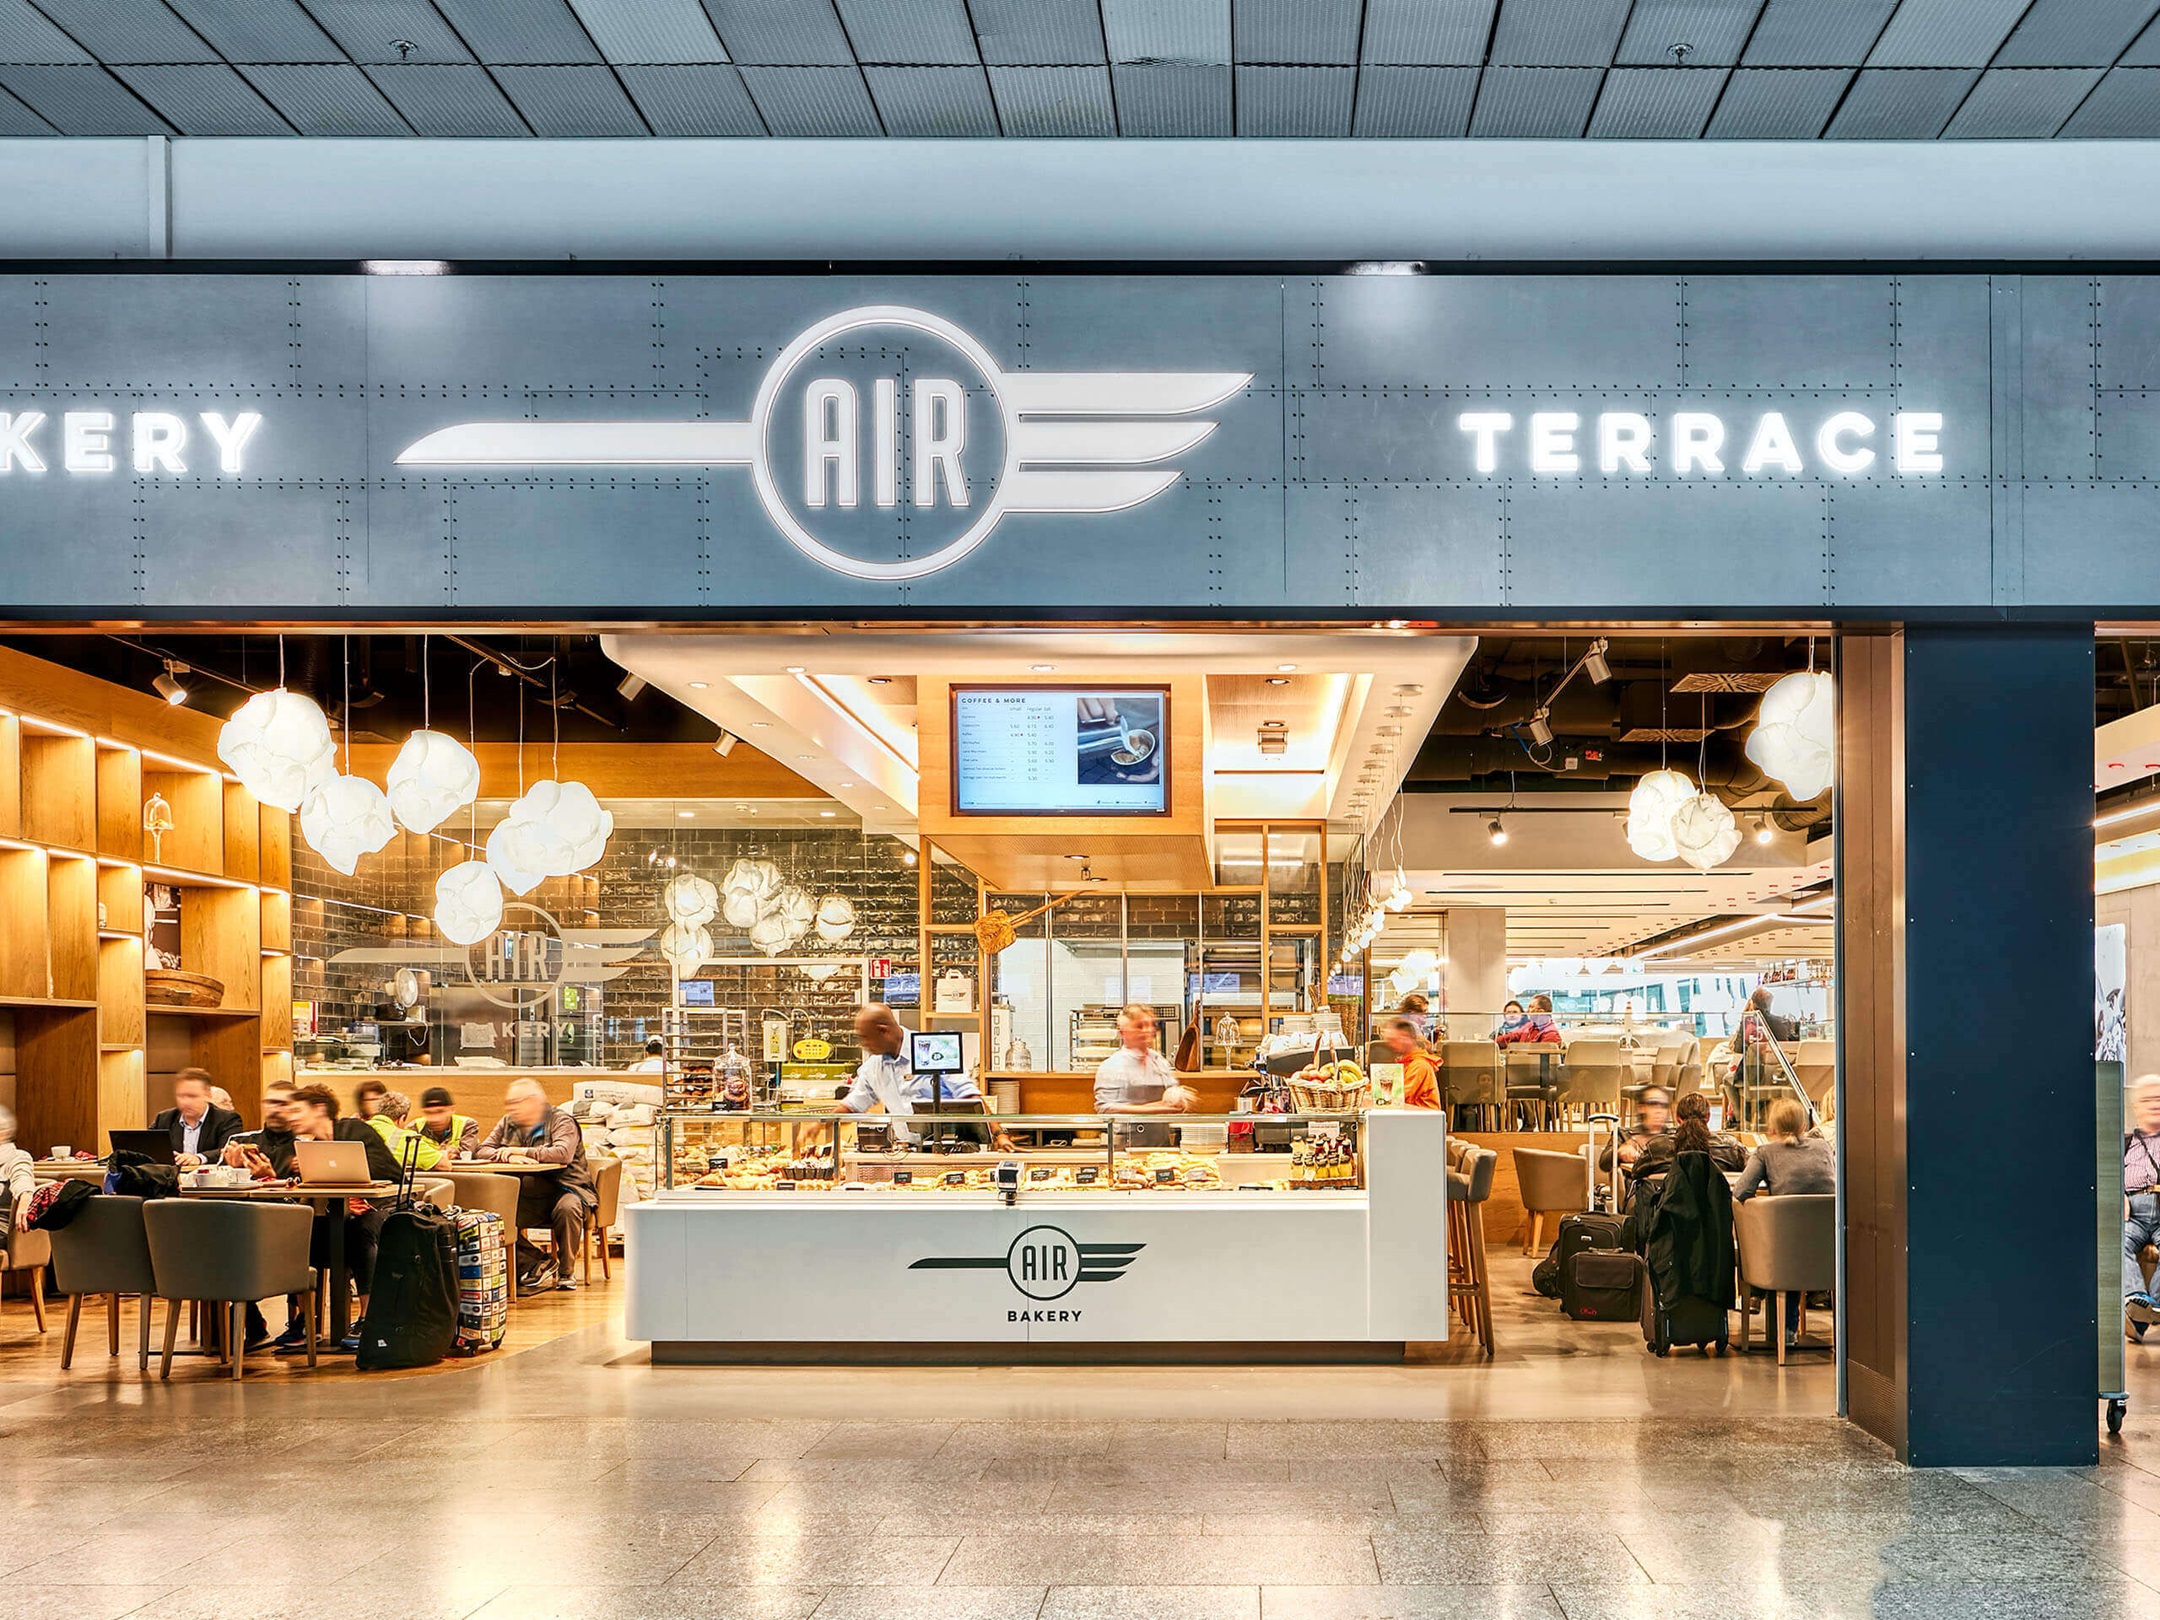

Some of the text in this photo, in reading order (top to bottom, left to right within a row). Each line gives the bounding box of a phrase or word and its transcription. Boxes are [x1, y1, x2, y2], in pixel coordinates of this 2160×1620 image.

[0, 412, 262, 472] KERY
[806, 378, 970, 507] AIR
[1458, 411, 1943, 472] TERRACE
[486, 930, 549, 980] AIR
[1022, 1245, 1068, 1281] AIR
[1007, 1310, 1082, 1322] BAKERY
